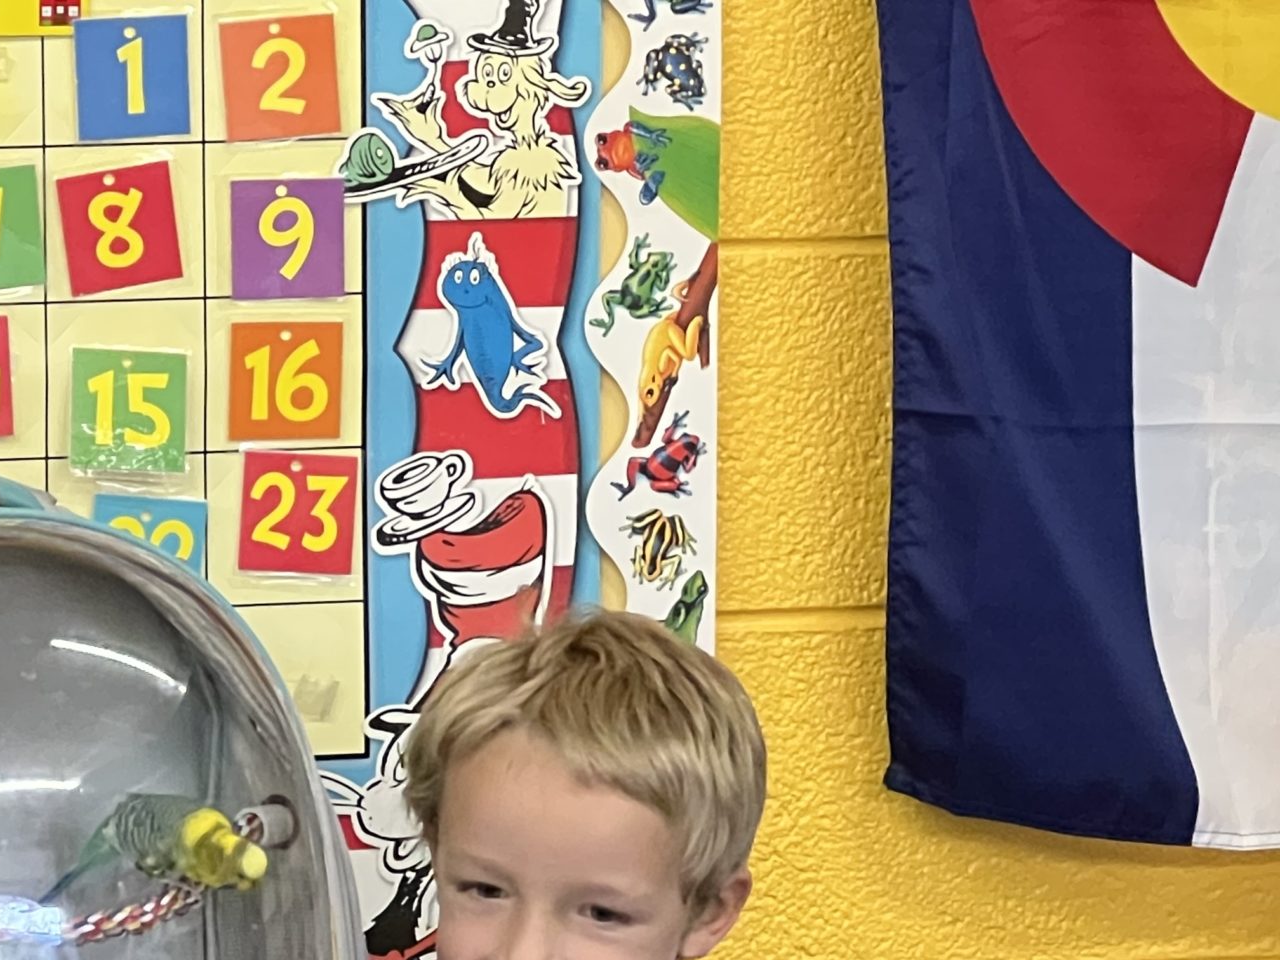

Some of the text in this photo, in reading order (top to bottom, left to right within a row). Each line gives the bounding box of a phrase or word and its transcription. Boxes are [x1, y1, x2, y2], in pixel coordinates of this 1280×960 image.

[116, 37, 146, 115] 1
[251, 37, 307, 115] 2
[87, 187, 144, 268] 8
[258, 196, 315, 281] 9
[86, 369, 171, 449] 15
[244, 339, 329, 422] 16
[250, 471, 349, 552] 23
